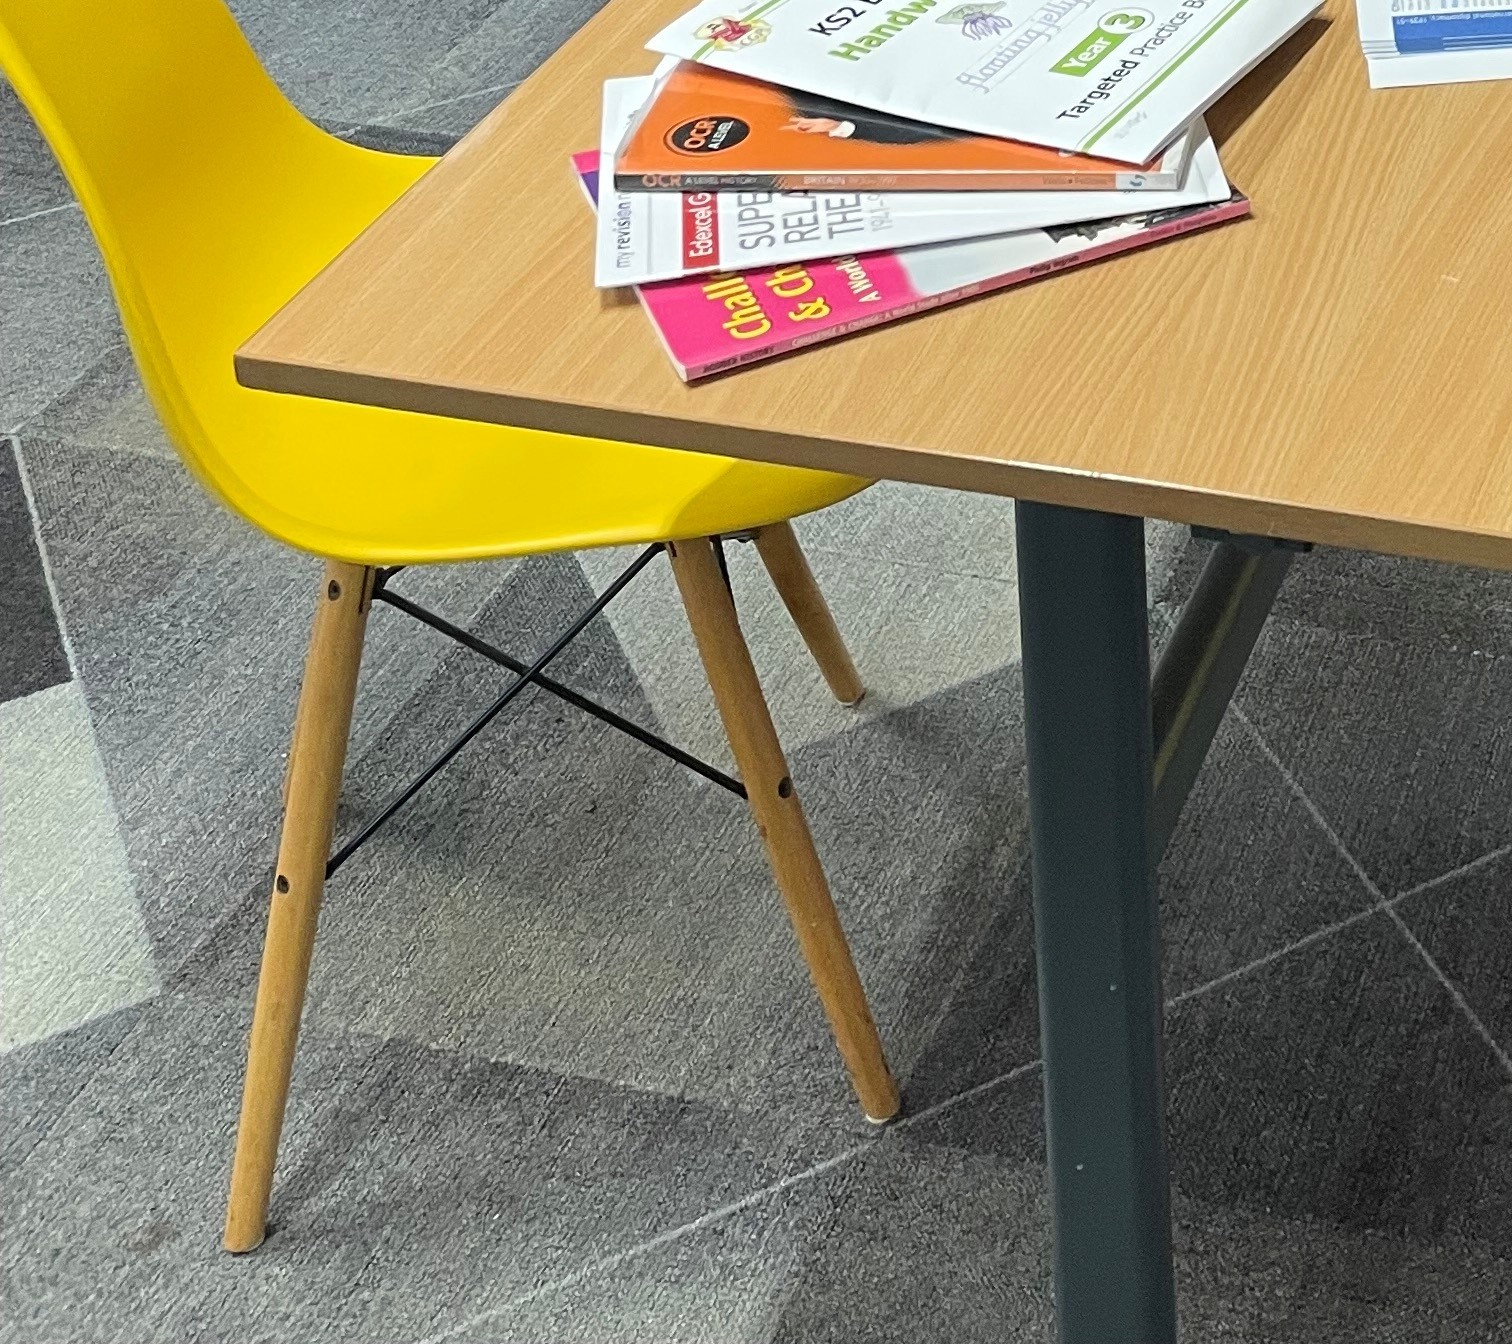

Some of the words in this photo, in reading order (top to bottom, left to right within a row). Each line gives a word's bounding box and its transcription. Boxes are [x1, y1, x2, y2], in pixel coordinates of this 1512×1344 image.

[808, 6, 867, 36] KS2
[1062, 36, 1113, 70] Year
[1104, 12, 1146, 30] 3
[1056, 58, 1141, 120] Targeted
[1129, 10, 1195, 58] Practice
[683, 118, 718, 149] OCR
[612, 204, 632, 250] revision
[688, 207, 713, 258] Edexcel
[825, 192, 865, 240] THE
[788, 296, 832, 322] &
[858, 289, 883, 303] A
